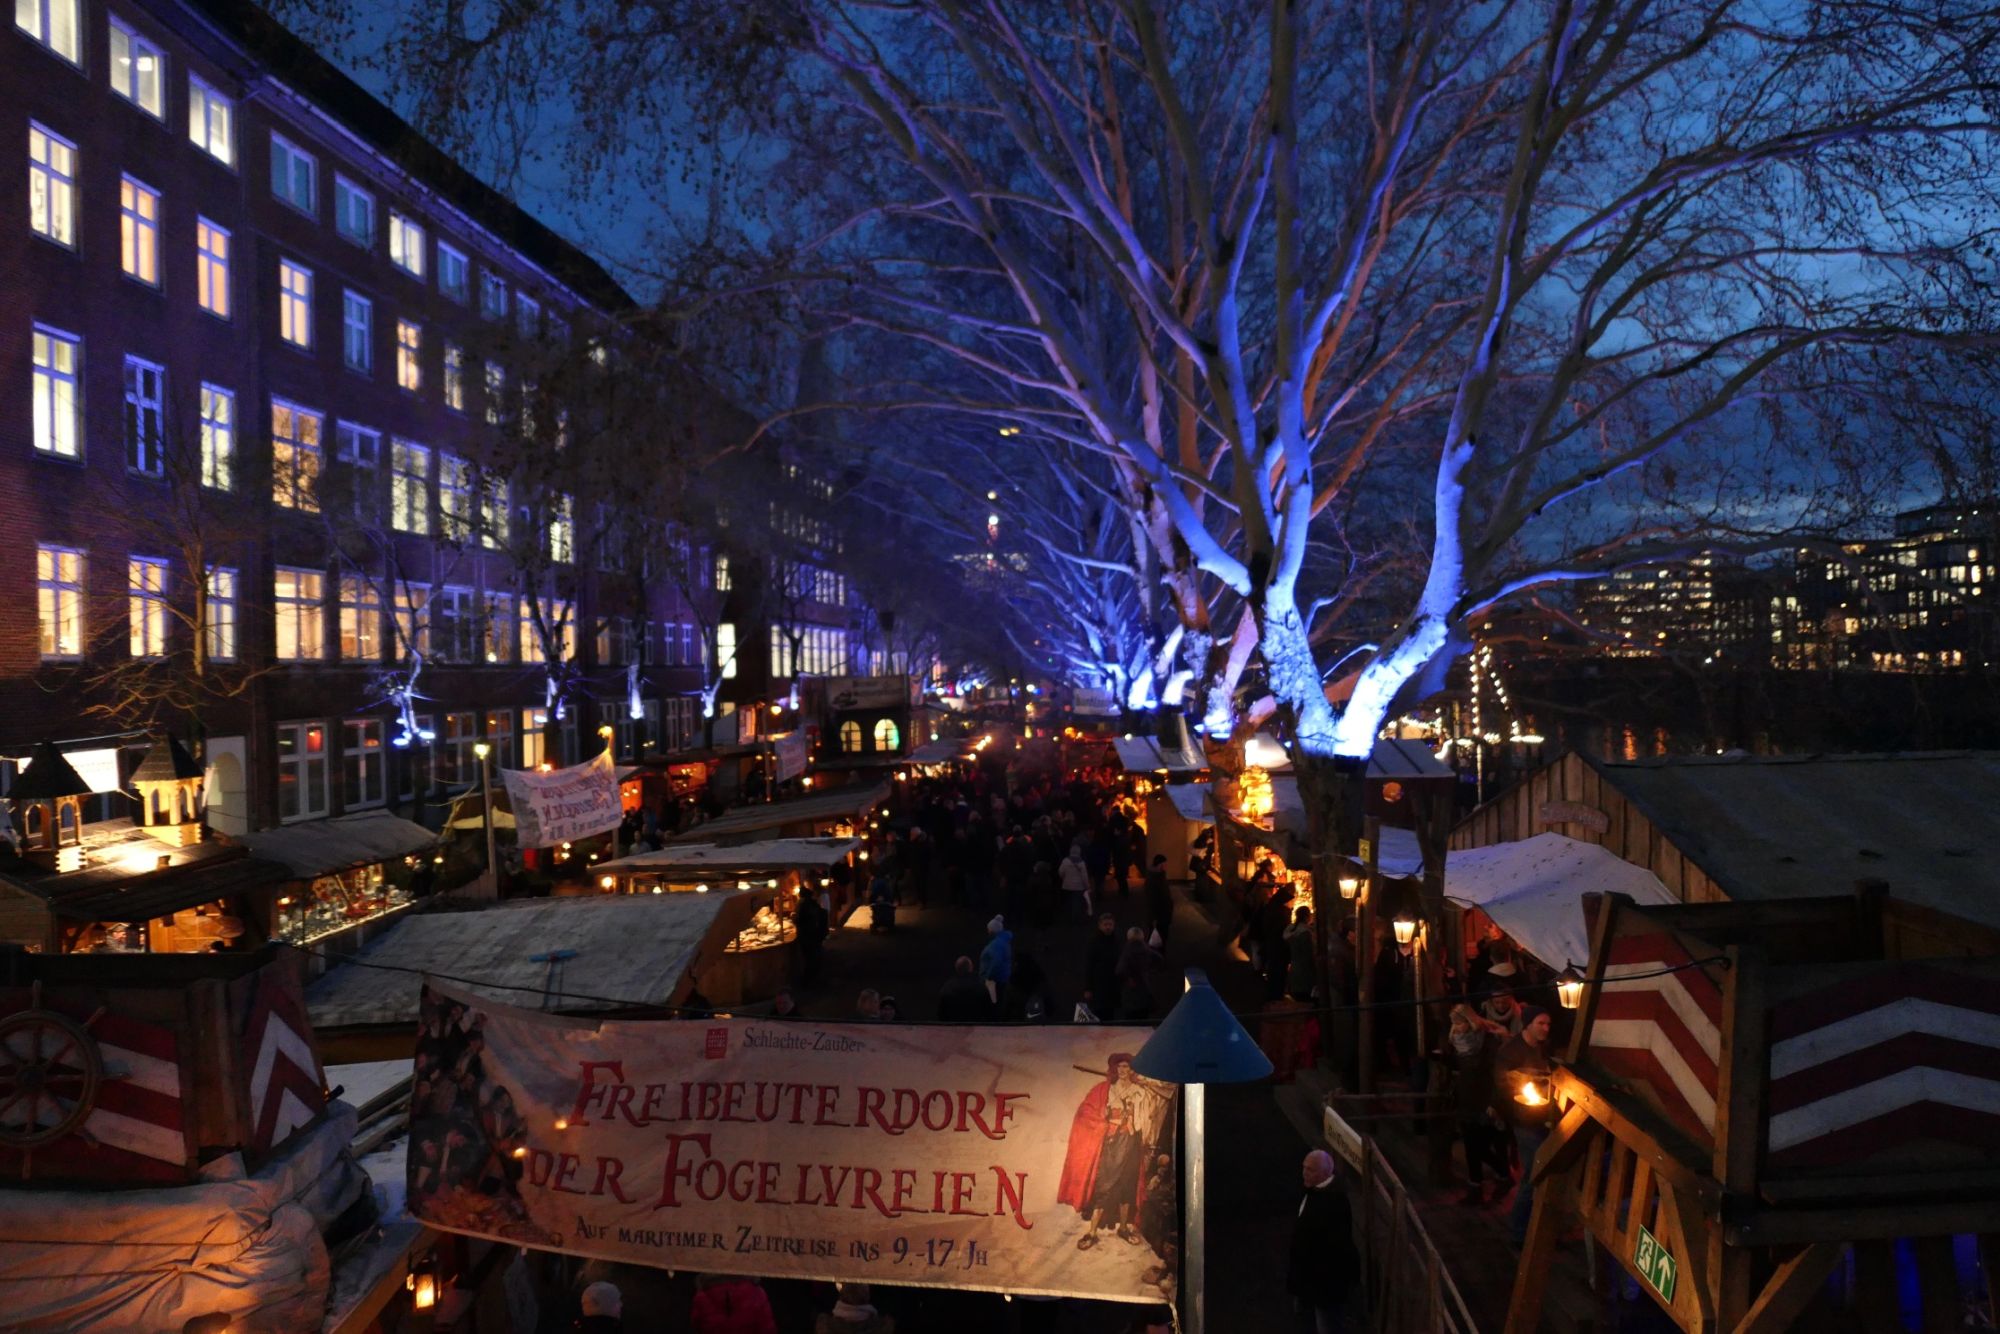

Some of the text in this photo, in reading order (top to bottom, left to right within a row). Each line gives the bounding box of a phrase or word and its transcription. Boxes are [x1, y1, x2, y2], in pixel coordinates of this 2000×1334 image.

[743, 1026, 866, 1053] Schlachte-Zauber
[567, 1060, 1031, 1141] FREIBEUTERDORF
[529, 1132, 1033, 1230] DER FOGELVREIEN
